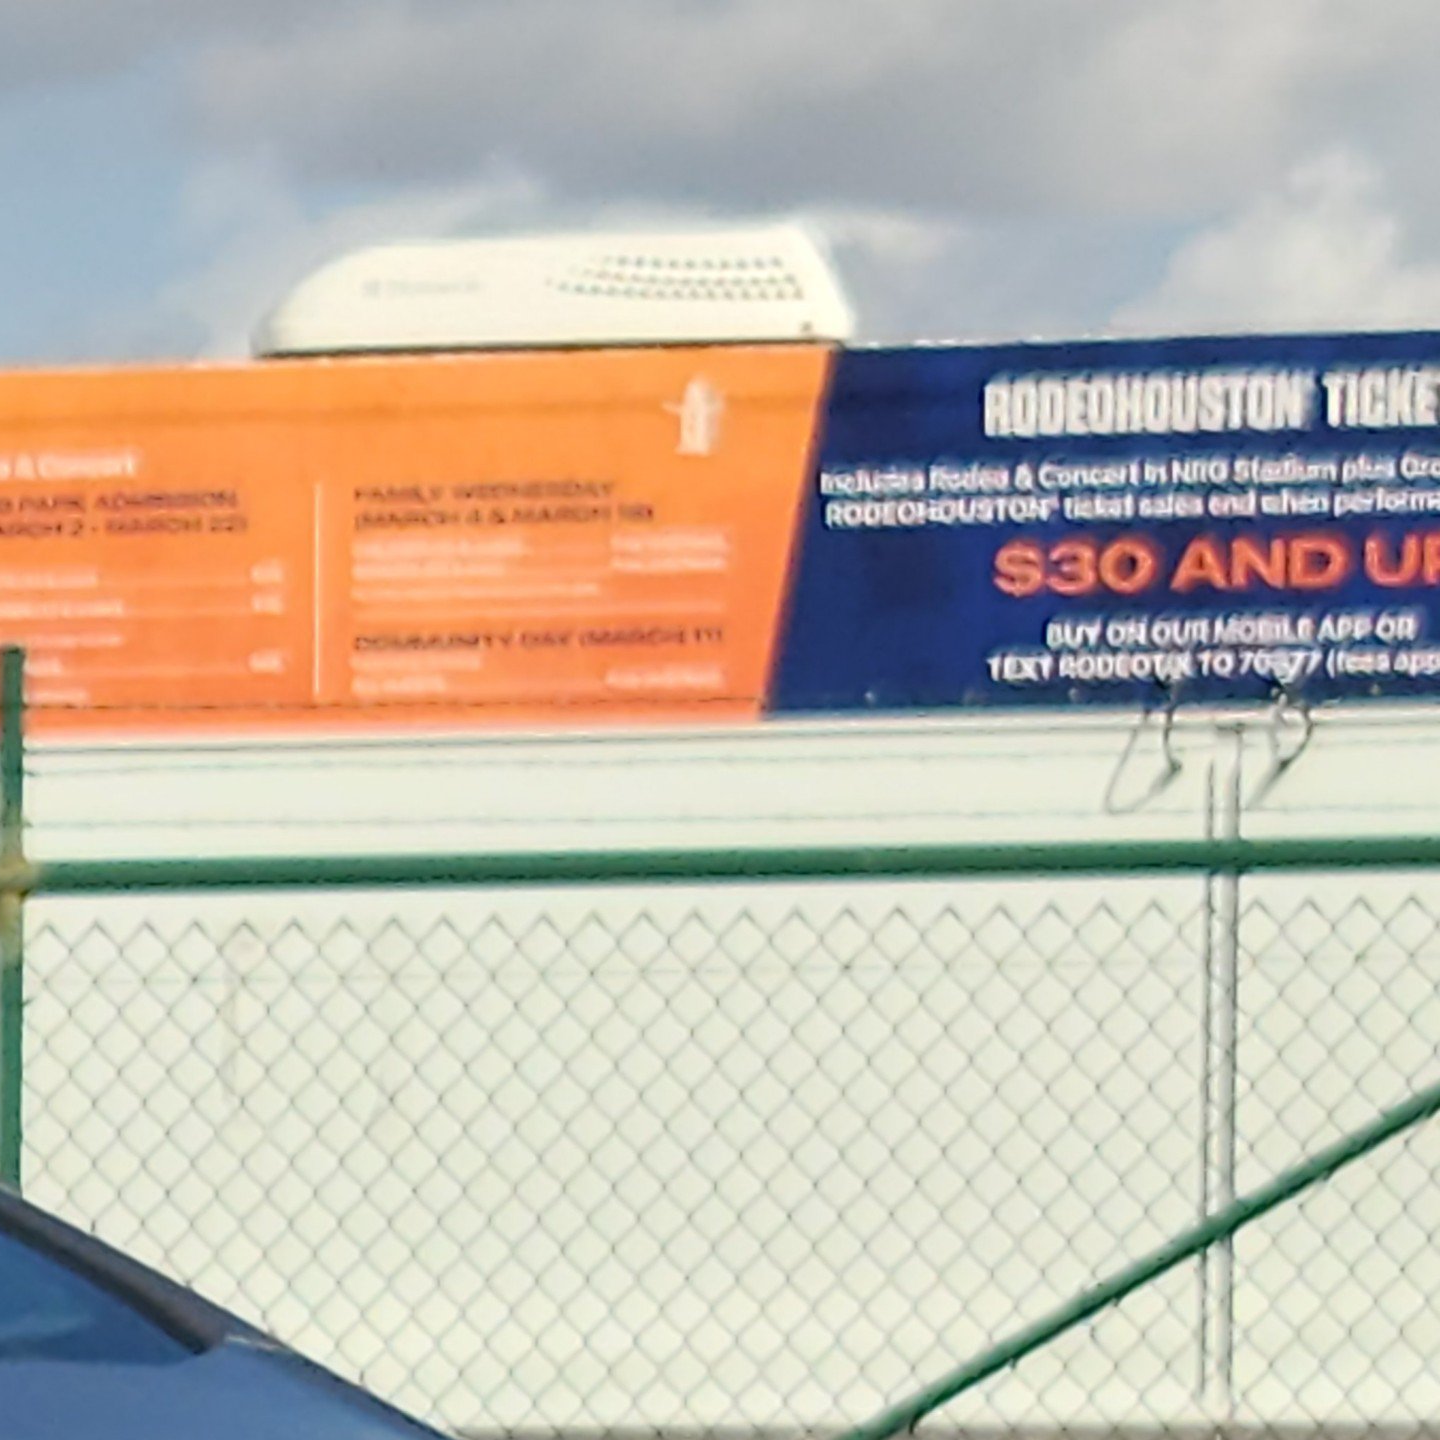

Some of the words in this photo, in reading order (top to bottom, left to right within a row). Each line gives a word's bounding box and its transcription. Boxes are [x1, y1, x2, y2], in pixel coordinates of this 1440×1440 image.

[1322, 369, 1440, 428] TICKE
[992, 535, 1158, 597] $30
[1169, 533, 1351, 593] AND
[1046, 616, 1100, 650] BUY
[1317, 612, 1372, 642] APP
[986, 653, 1052, 682] TEXT
